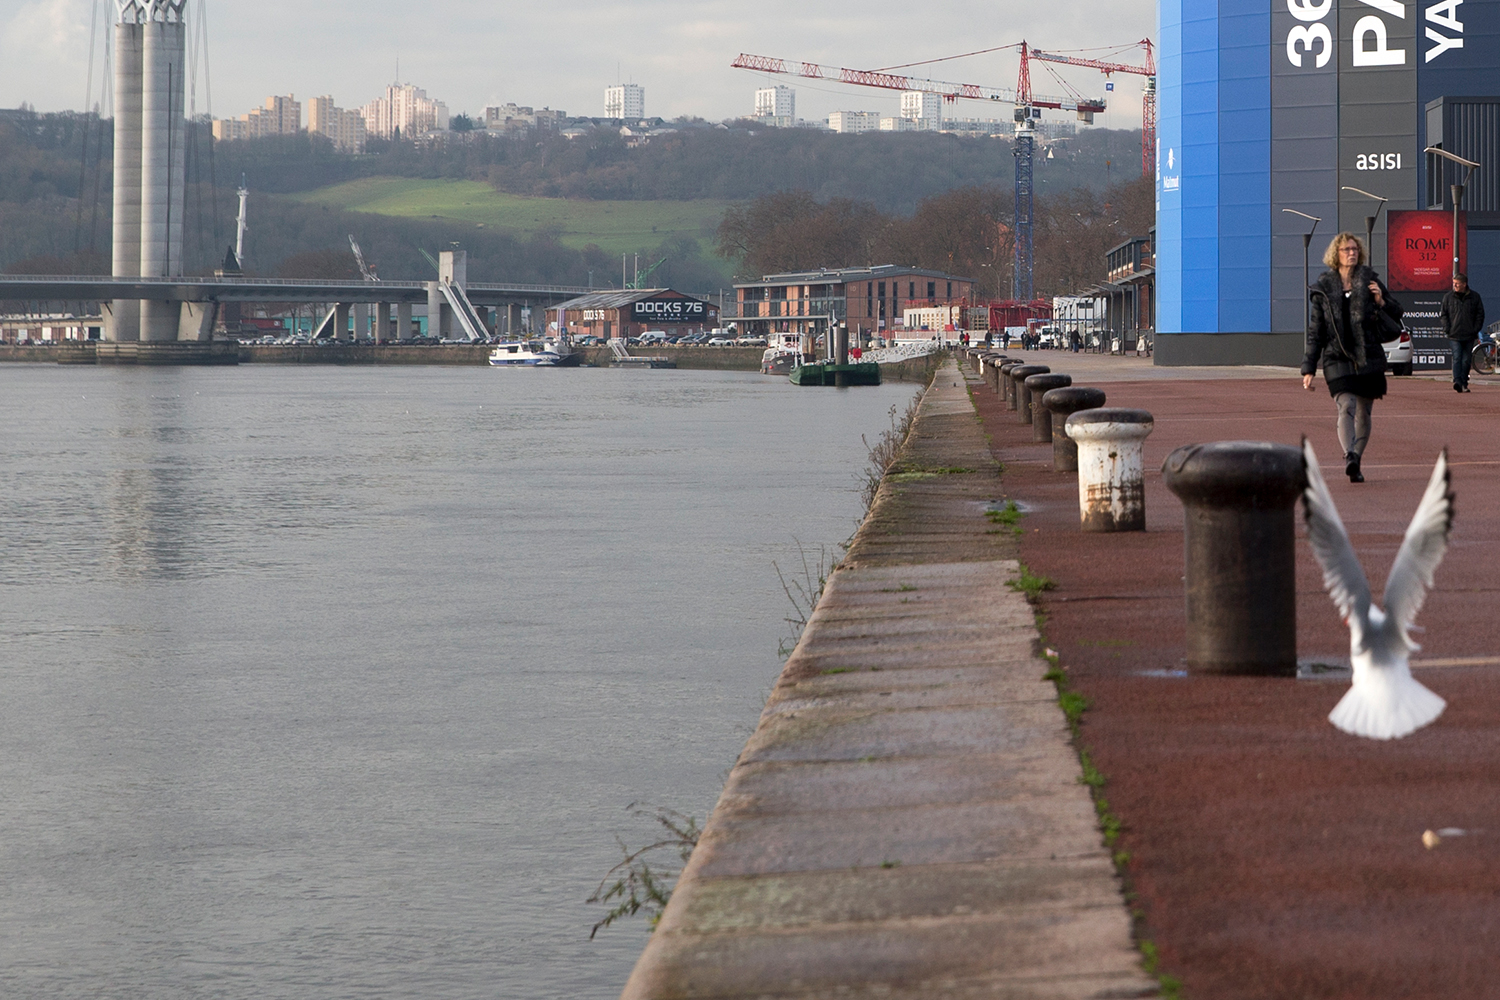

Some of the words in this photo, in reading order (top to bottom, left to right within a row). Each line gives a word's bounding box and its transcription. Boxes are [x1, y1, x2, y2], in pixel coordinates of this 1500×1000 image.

[1418, 252, 1437, 261] 312
[635, 302, 682, 313] DOCKS
[685, 302, 703, 312] 76
